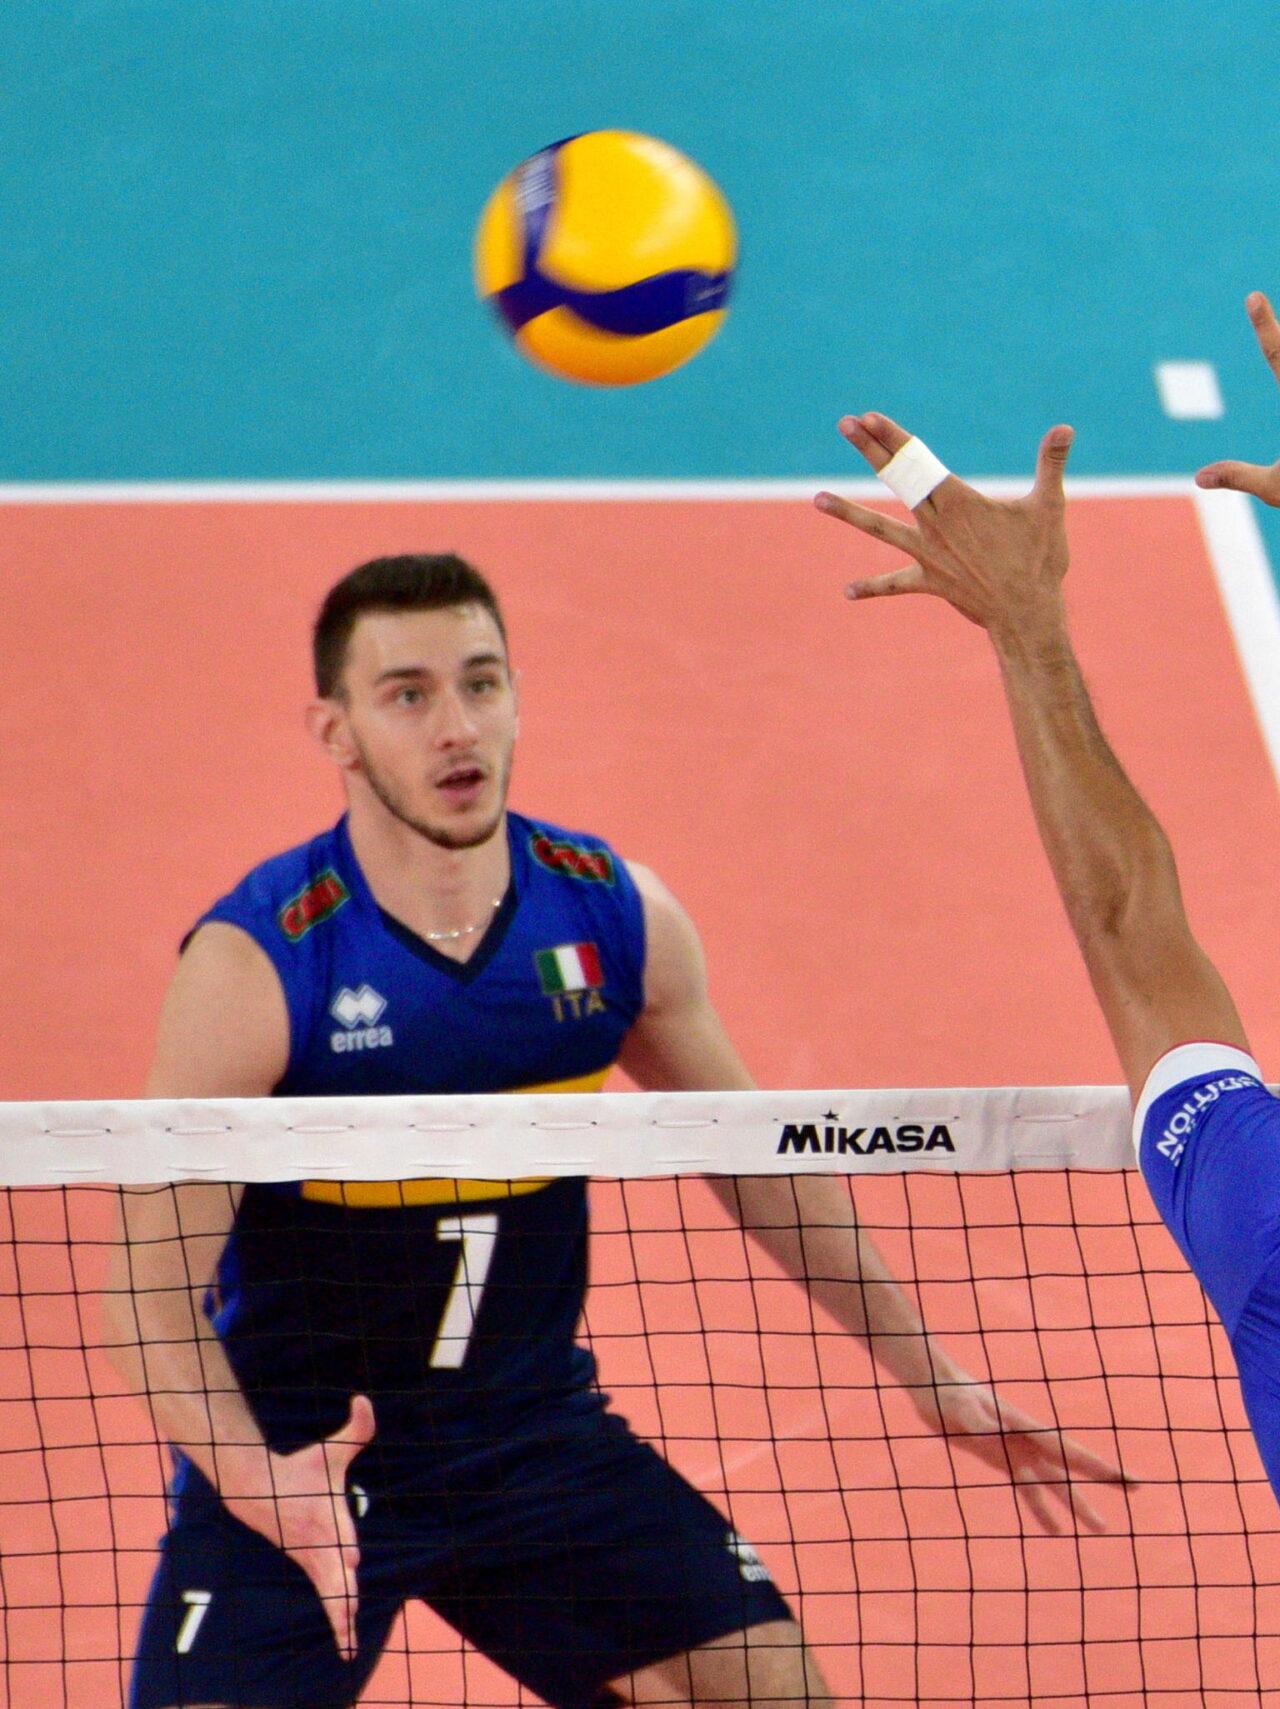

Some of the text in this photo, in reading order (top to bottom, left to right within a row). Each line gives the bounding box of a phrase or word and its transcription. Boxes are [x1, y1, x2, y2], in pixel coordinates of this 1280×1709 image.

[552, 990, 607, 1023] ITA
[776, 1124, 956, 1155] MIKASA
[429, 1213, 499, 1369] 7
[176, 1590, 212, 1653] 7
